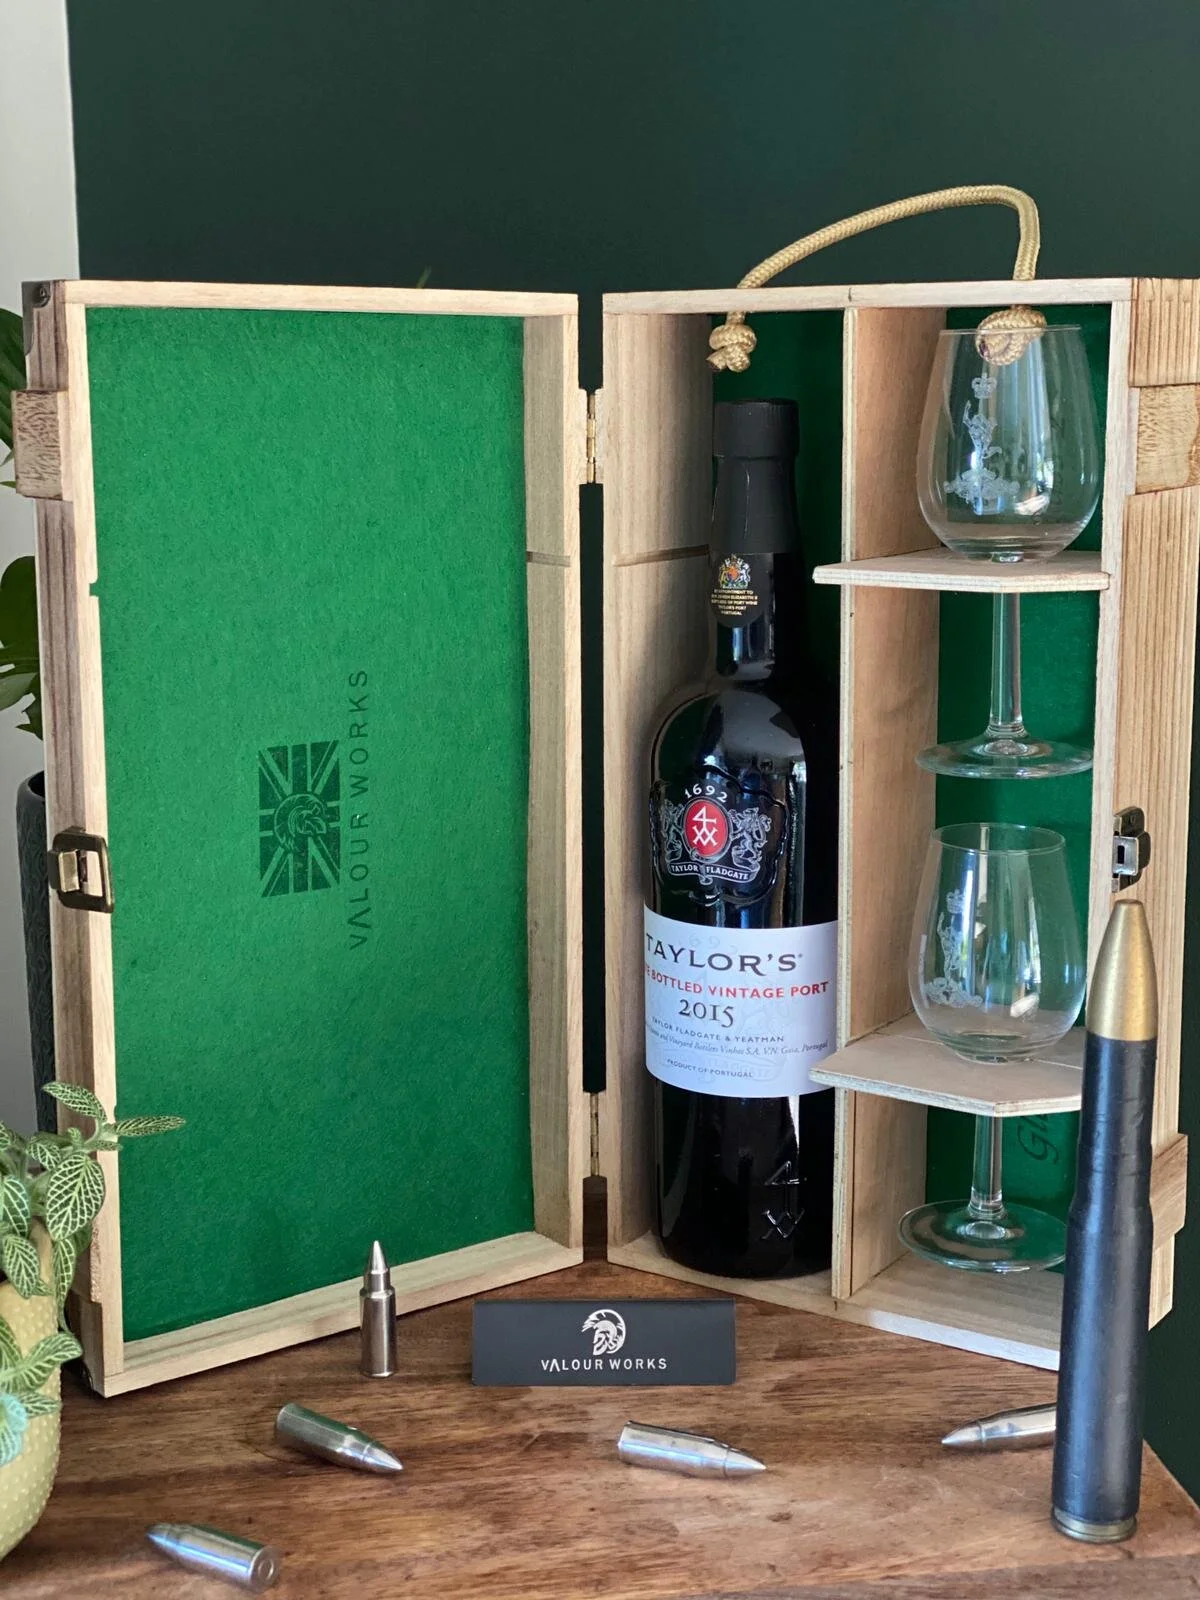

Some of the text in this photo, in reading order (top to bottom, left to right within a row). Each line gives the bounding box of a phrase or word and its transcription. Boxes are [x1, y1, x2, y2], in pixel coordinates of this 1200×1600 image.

[684, 783, 728, 802] 1692
[347, 669, 372, 951] VALOUR WORKS
[671, 864, 749, 880] TAYLOR FLADGATE
[645, 932, 797, 977] TAYLOR'S
[651, 972, 830, 999] BOTTLED VINTAGE PORT
[678, 999, 735, 1028] 2015
[652, 1016, 673, 1032] TAYLOR
[675, 1026, 721, 1041] FLADGATE
[735, 1035, 785, 1043] YEATMAN
[667, 1058, 697, 1072] PRODUCT
[709, 1068, 753, 1078] PORTUGAL
[541, 1358, 668, 1372] VALOUR WORKS
